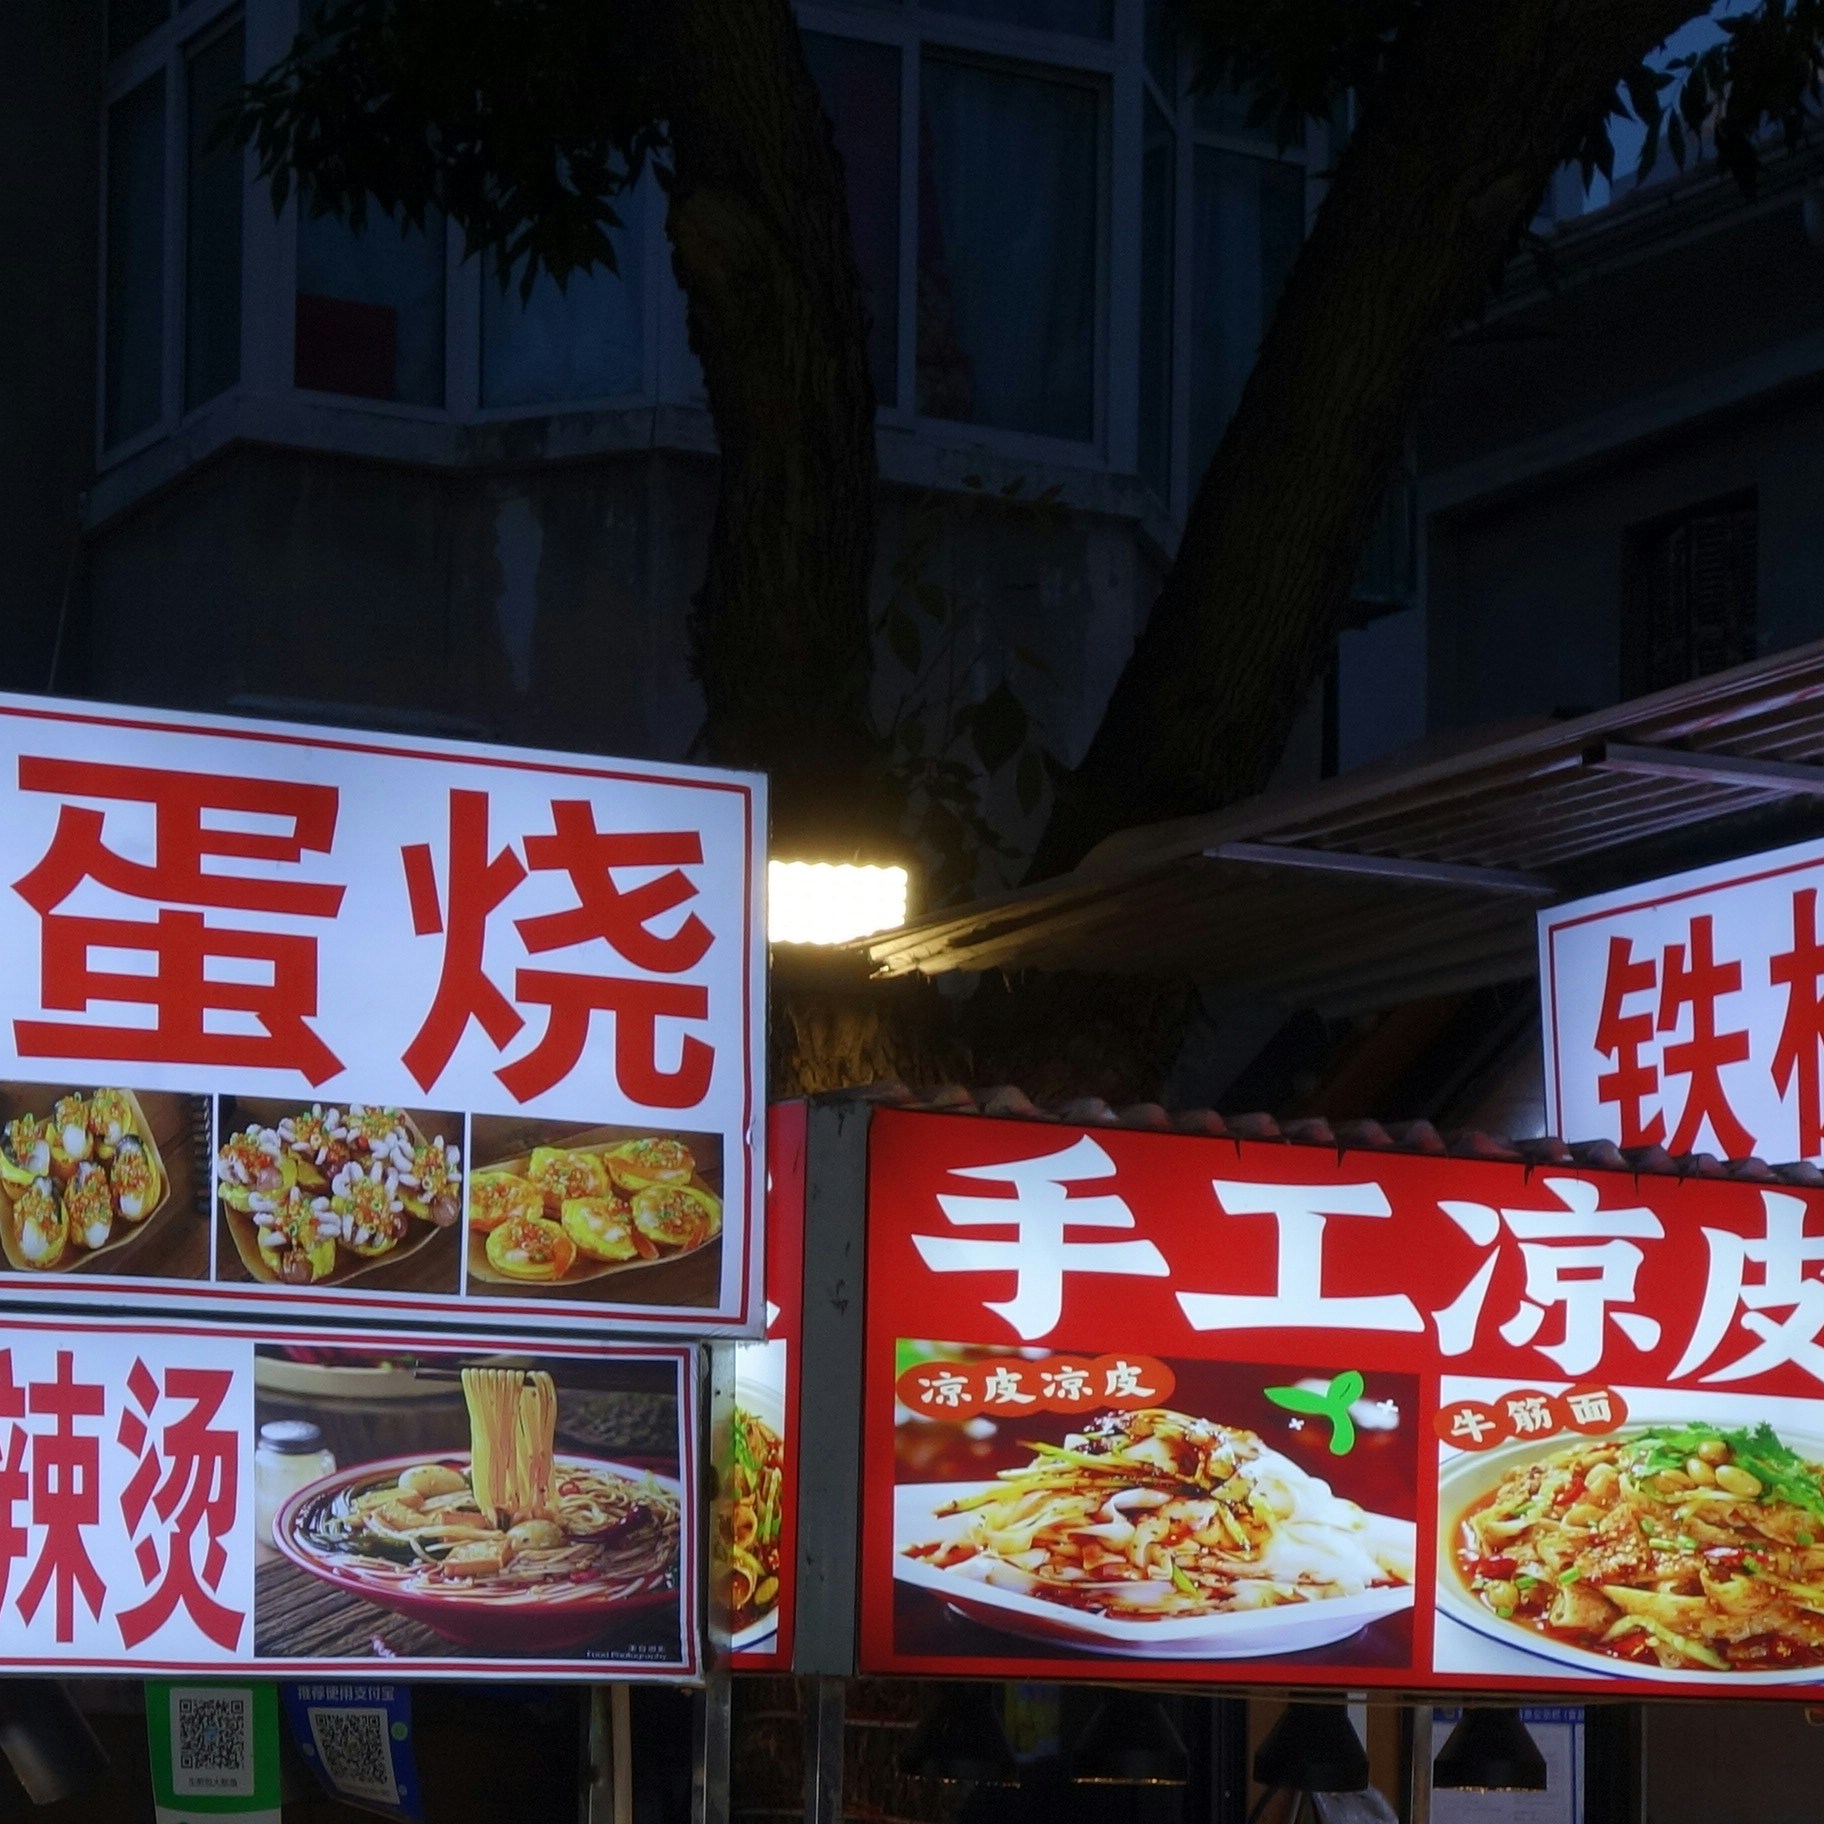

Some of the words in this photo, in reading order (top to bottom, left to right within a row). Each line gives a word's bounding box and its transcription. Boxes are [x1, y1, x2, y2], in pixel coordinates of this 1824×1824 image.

[917, 1360, 1157, 1408] 凉皮凉皮
[1450, 1392, 1612, 1445] 牛筋面
